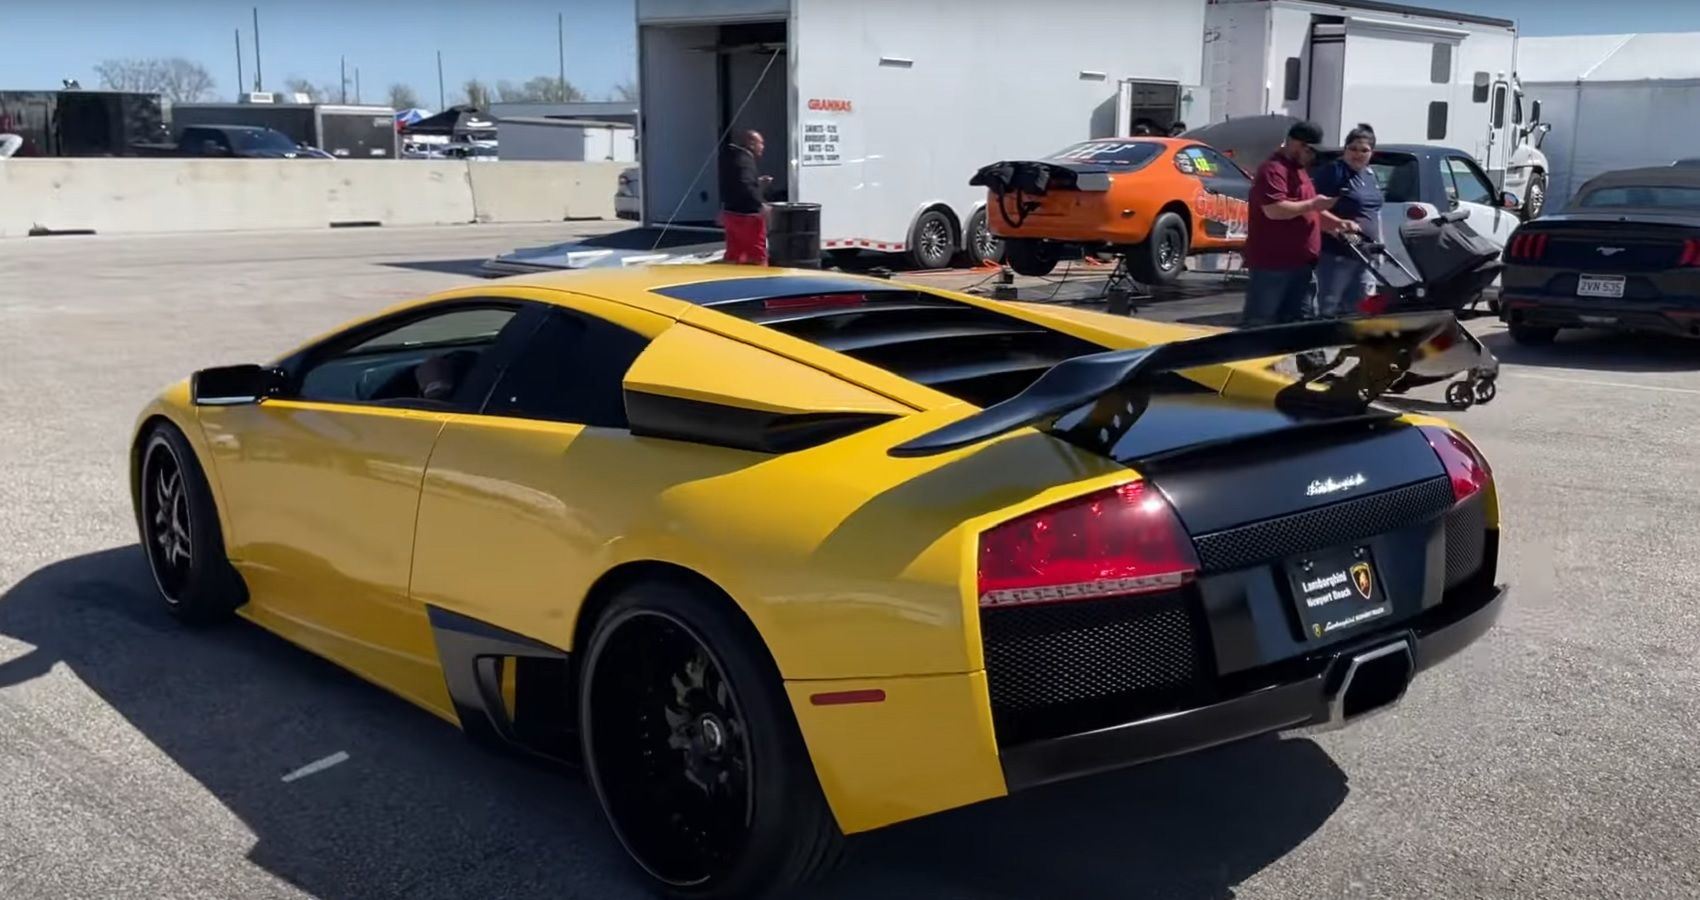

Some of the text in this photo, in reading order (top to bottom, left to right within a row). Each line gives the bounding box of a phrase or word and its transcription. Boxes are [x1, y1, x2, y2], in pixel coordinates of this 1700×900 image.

[1302, 570, 1347, 593] Lamborghini
[1306, 587, 1352, 607] Newport Beach
